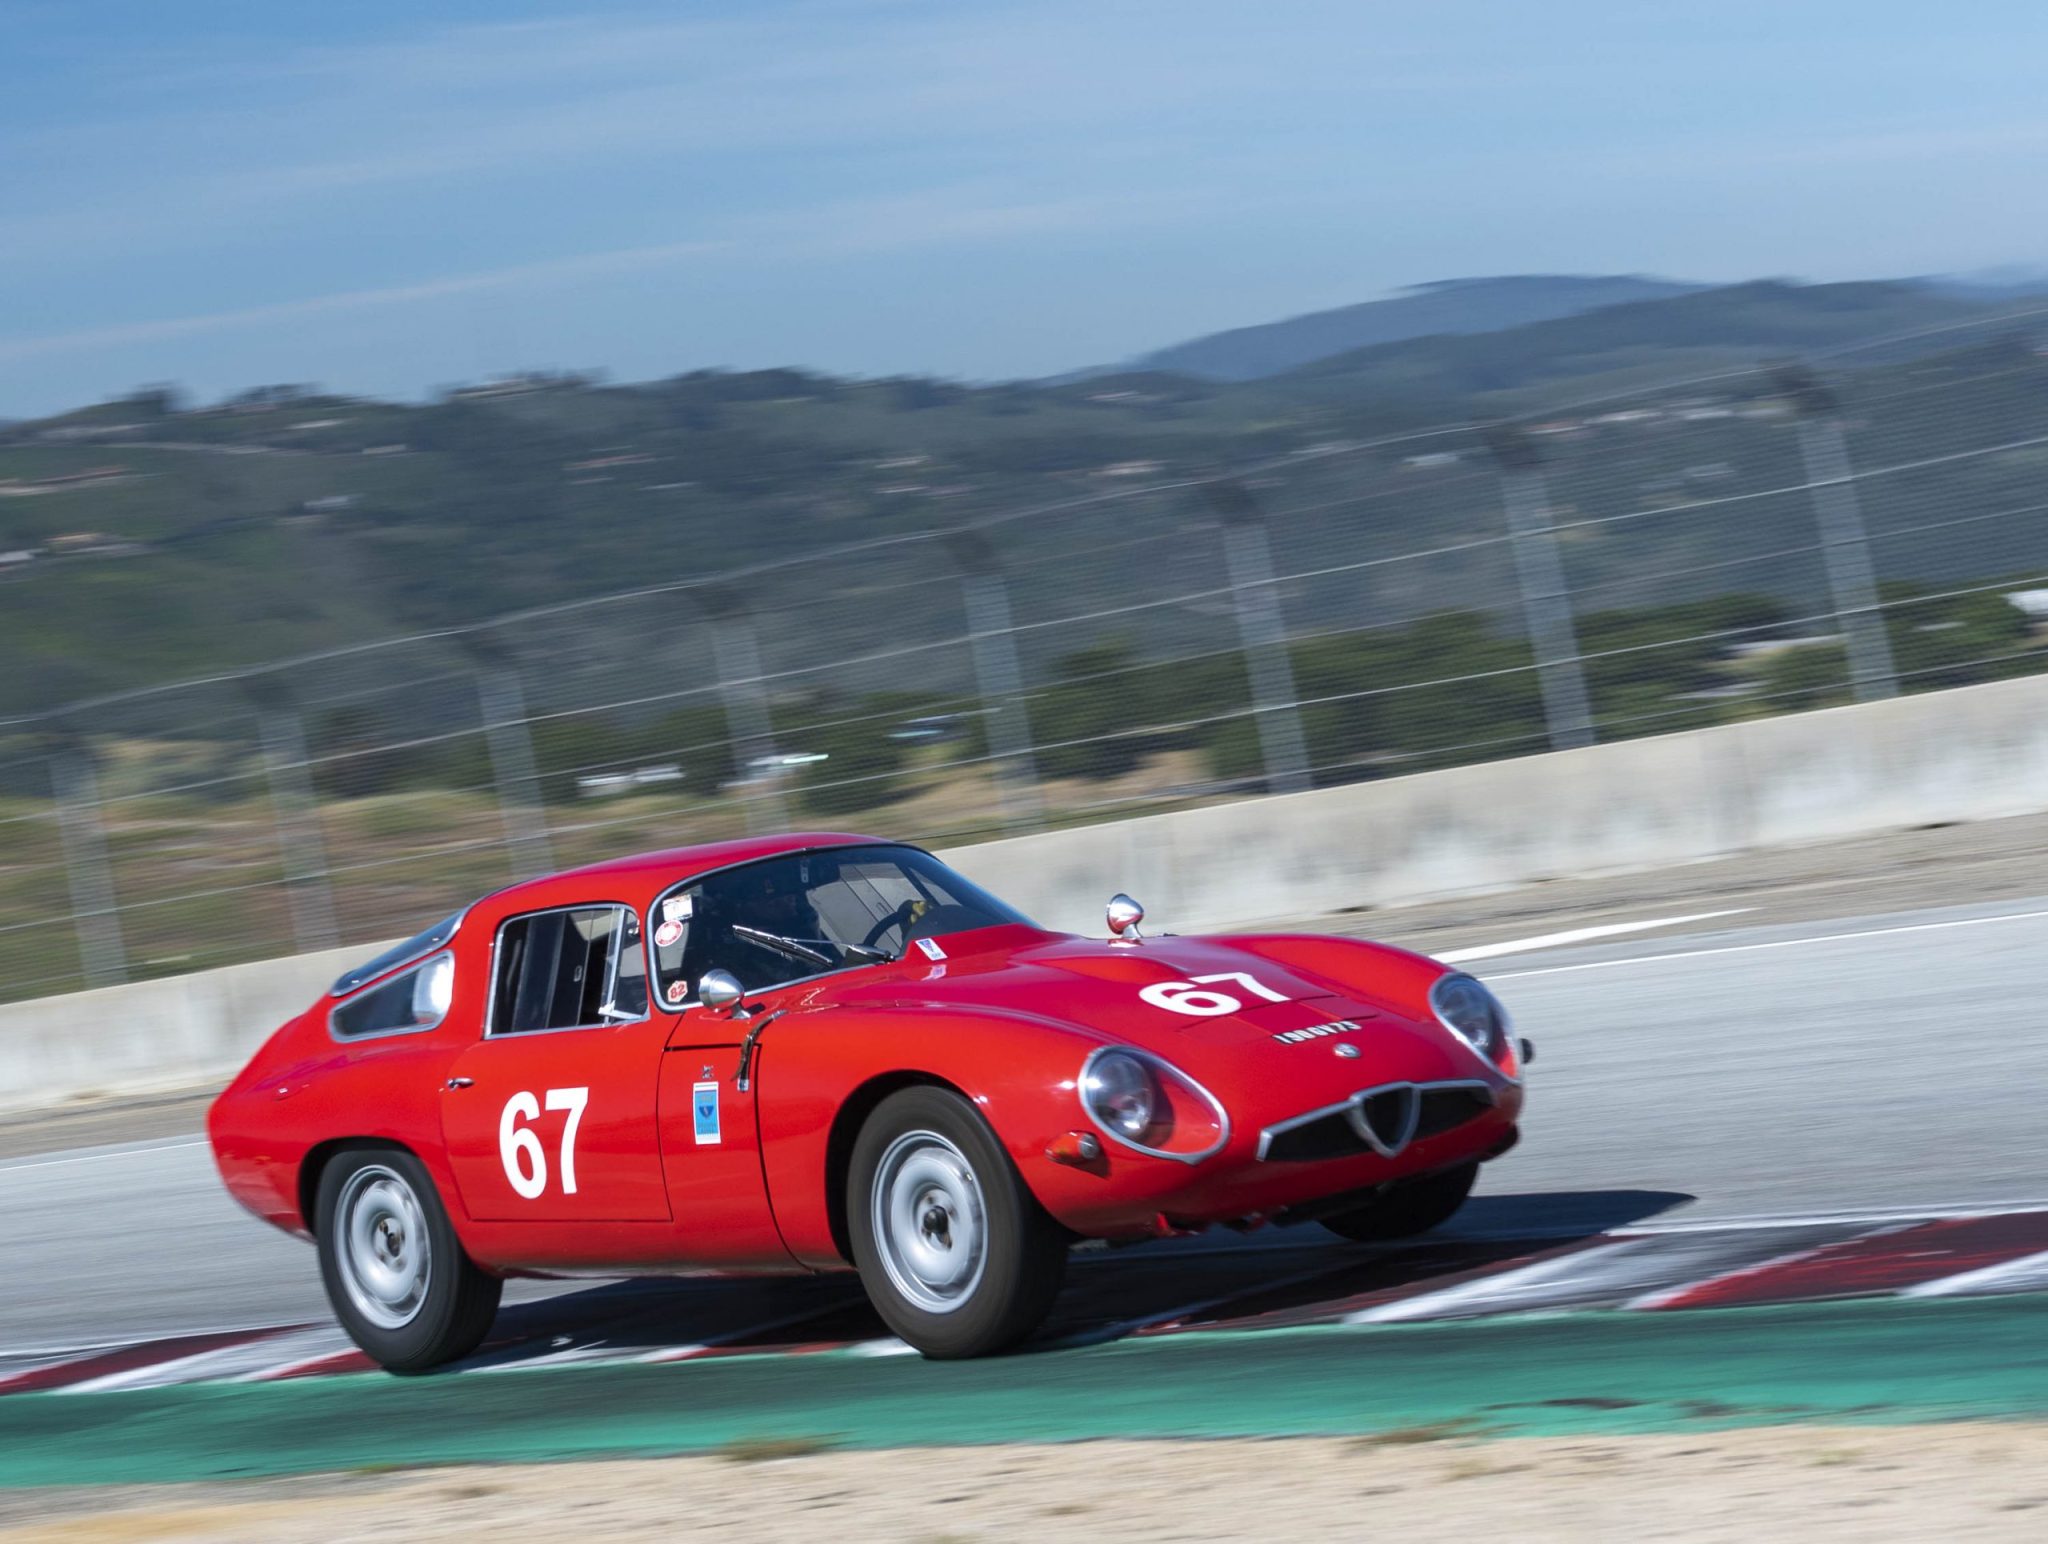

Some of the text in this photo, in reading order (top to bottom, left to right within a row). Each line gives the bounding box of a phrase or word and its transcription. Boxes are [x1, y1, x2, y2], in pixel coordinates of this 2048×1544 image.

[670, 983, 686, 999] 82
[1138, 972, 1292, 1016] 67
[499, 1087, 589, 1200] 67
